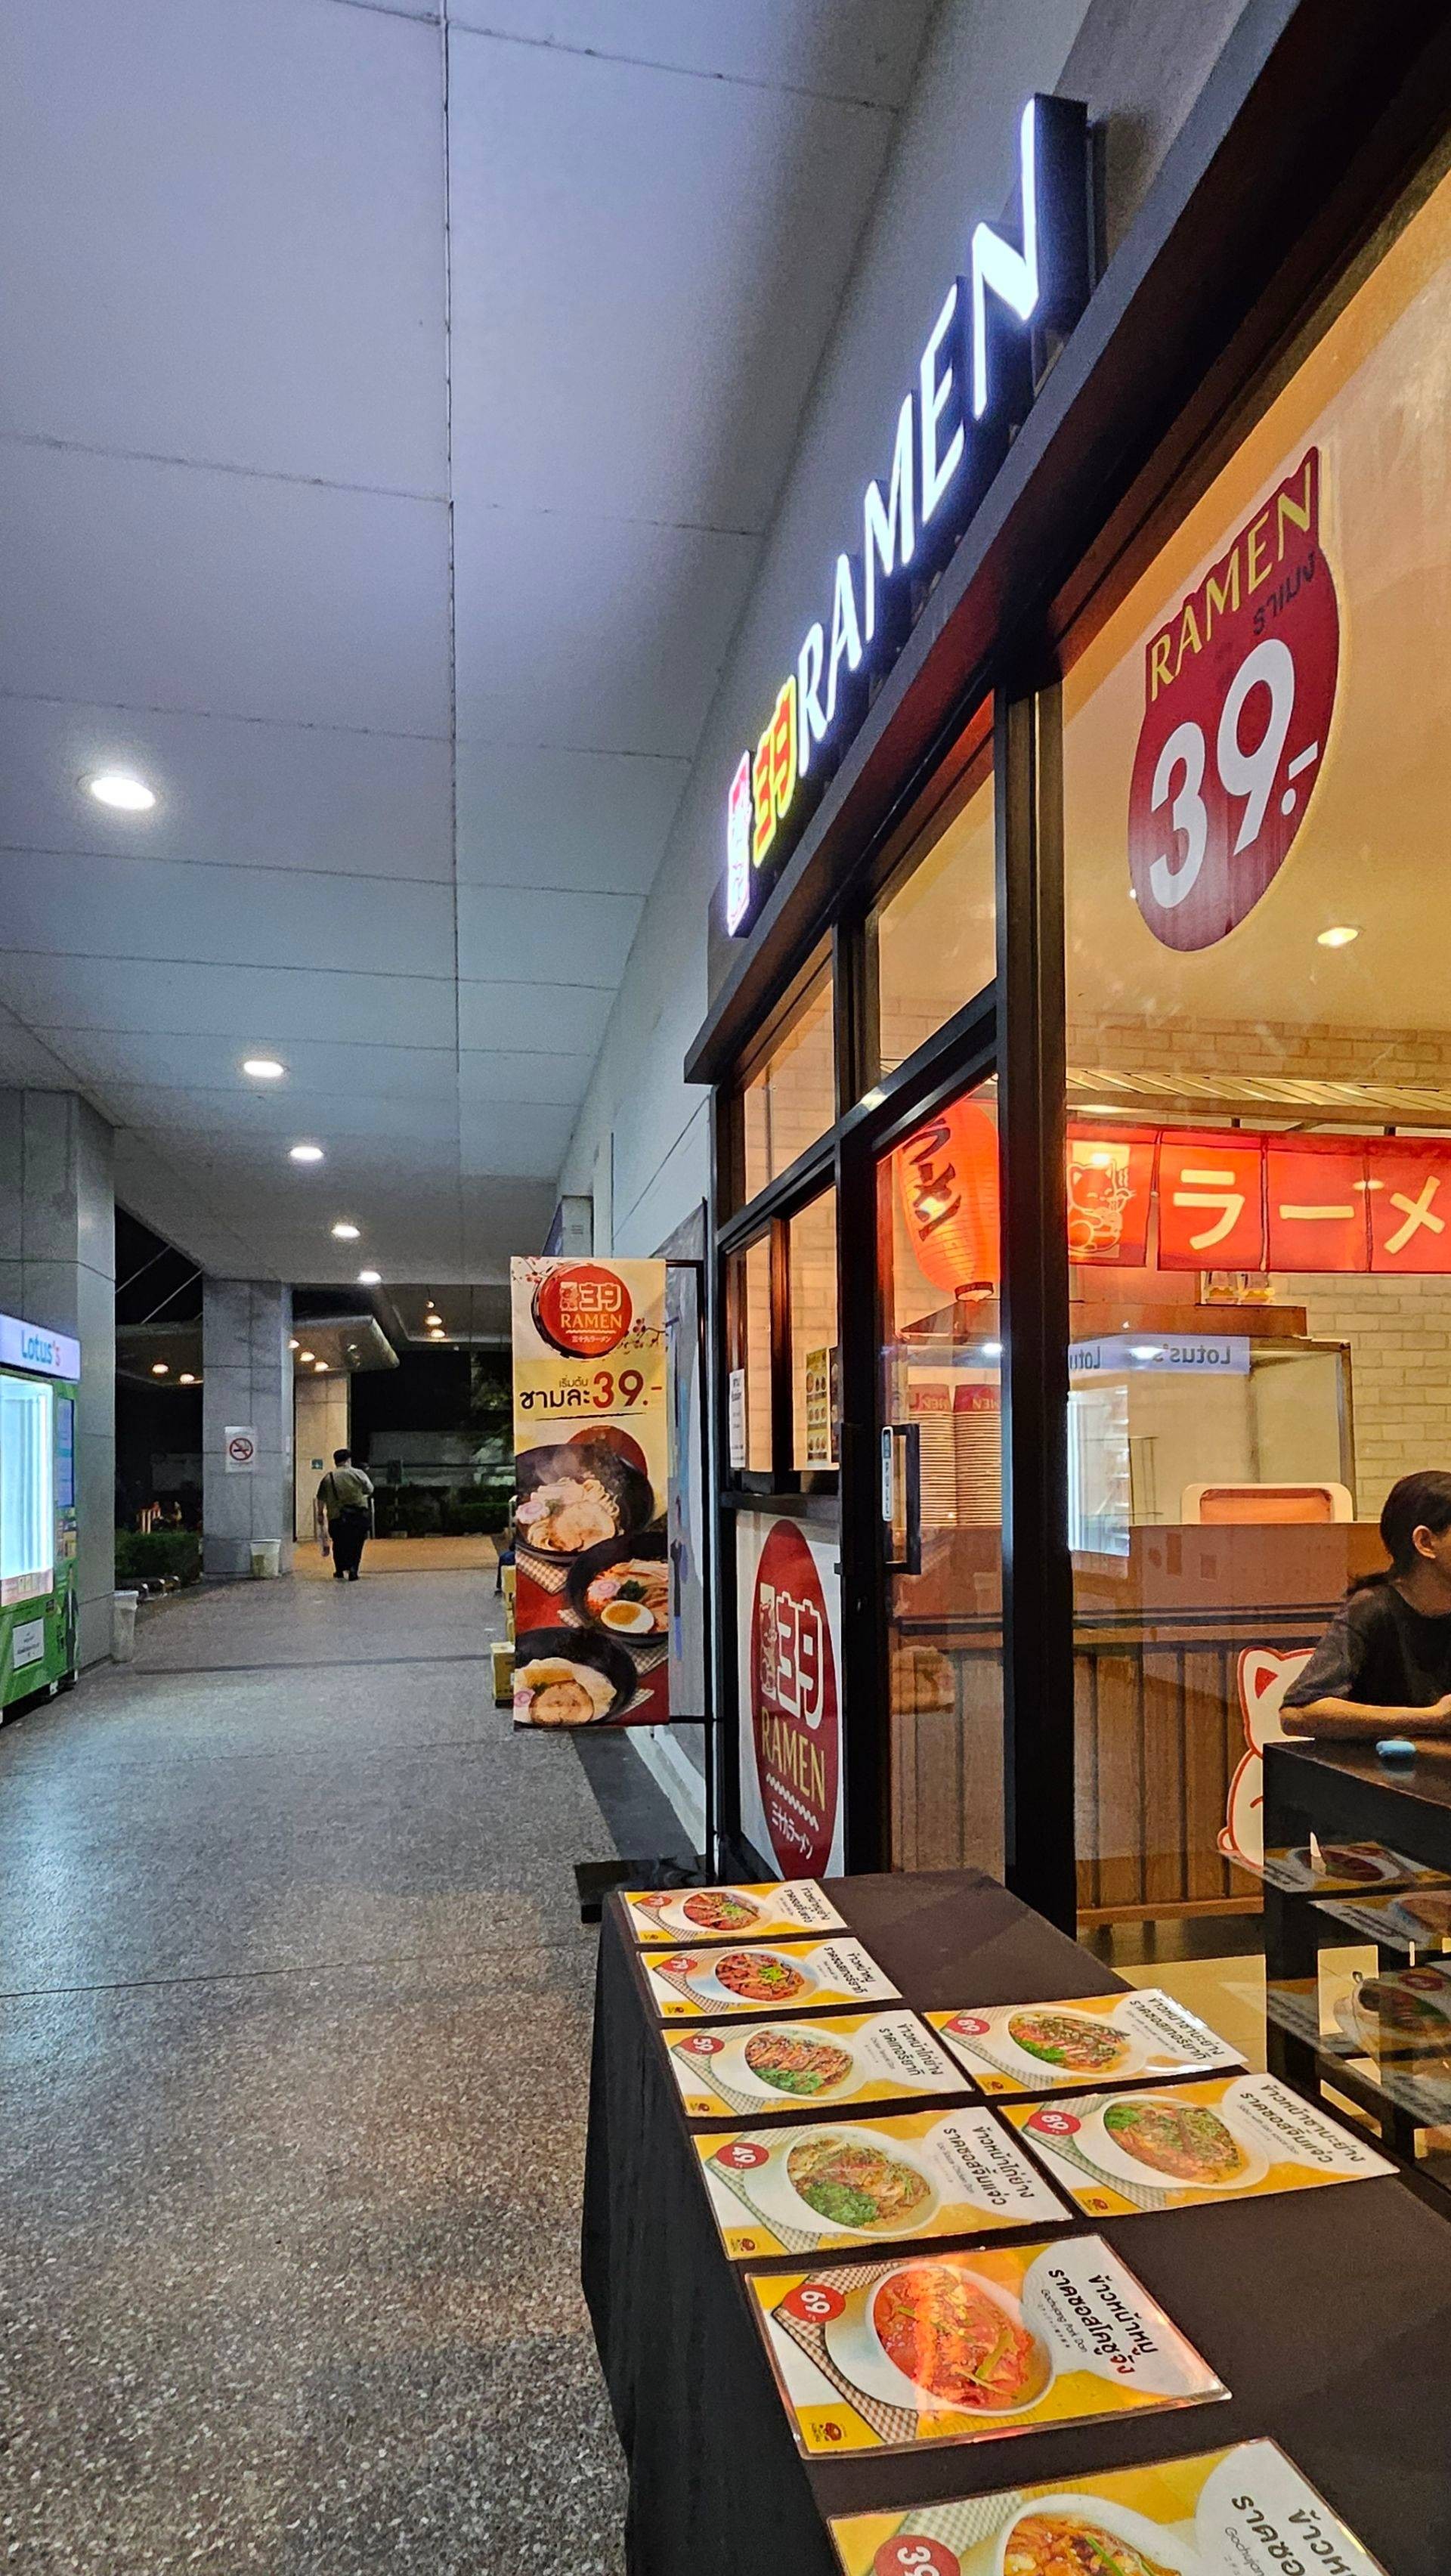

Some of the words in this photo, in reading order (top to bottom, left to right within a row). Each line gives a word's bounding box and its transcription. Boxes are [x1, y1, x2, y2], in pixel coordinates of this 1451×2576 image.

[797, 96, 1037, 779] RAMEN
[1150, 461, 1311, 703] RAMEN
[1149, 638, 1318, 909] 39.-
[21, 1330, 61, 1367] Lotus's
[560, 1313, 622, 1329] RAMEN
[519, 1388, 590, 1410] ชามละ
[558, 1374, 589, 1388] เริ่มต้น
[761, 1705, 826, 1813] RAMEN
[897, 2023, 943, 2075] ข้าวหน้าไก่ย่าง
[1240, 2093, 1333, 2163] ราดซอสจิ้มแจ่ว
[1261, 2085, 1365, 2162] ข้าวหน้าซาบะย่าง
[944, 2129, 1010, 2205] ราดซอสจิ้มแจ่ว
[973, 2126, 1035, 2197] ข้าวหน้าไก่ย่าง
[1088, 2274, 1159, 2355] ข้าวหน้าหมู
[1288, 2508, 1357, 2576] ข้าวห
